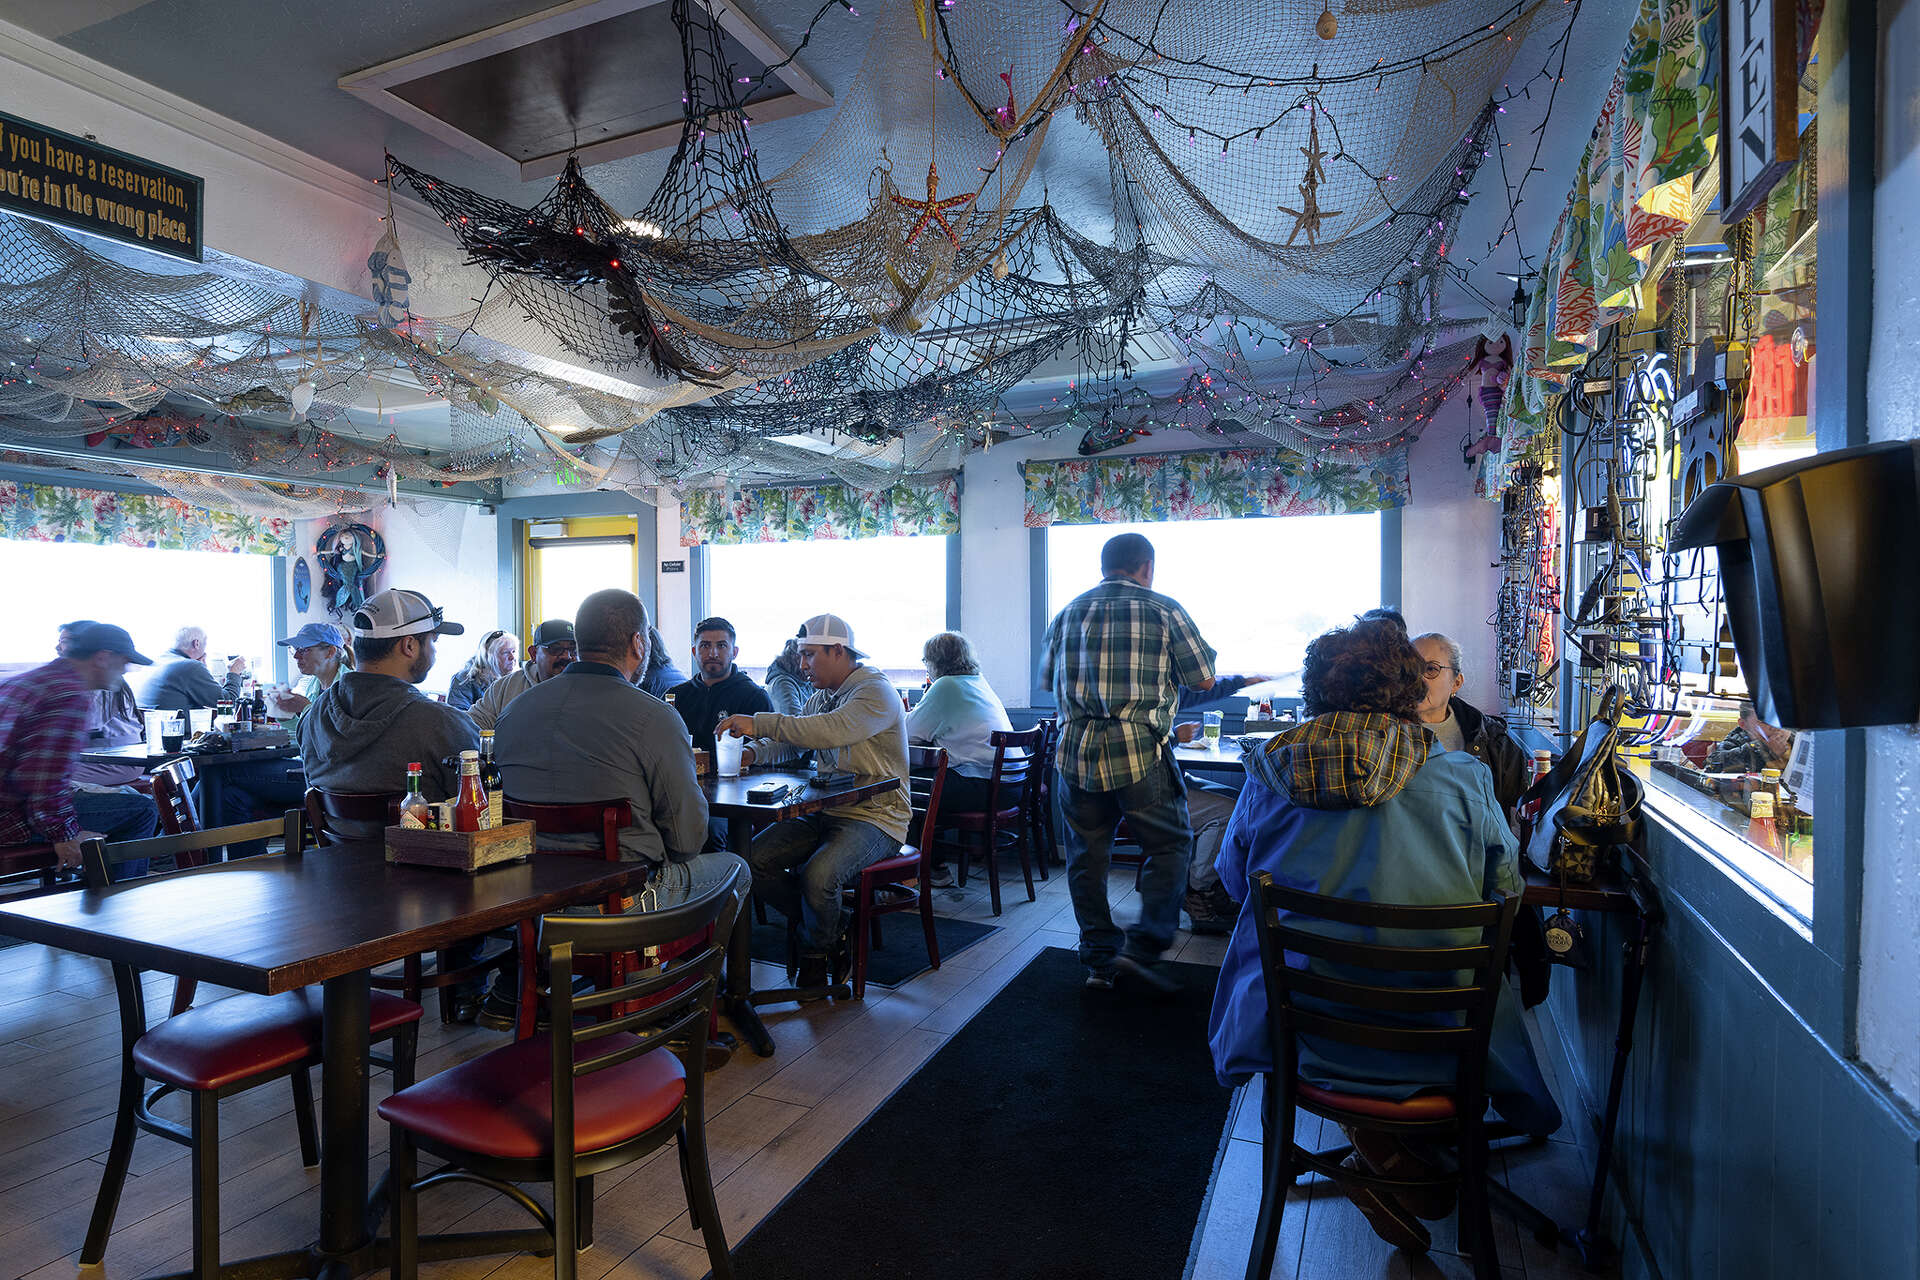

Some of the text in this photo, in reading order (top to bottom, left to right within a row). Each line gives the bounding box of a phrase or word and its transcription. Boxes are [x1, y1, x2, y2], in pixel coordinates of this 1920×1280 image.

[1738, 0, 1768, 193] PEN
[0, 168, 191, 244] ou're in the wrong place.
[9, 133, 40, 163] you
[45, 138, 84, 177] have
[88, 158, 97, 182] a
[101, 162, 189, 212] reservation,
